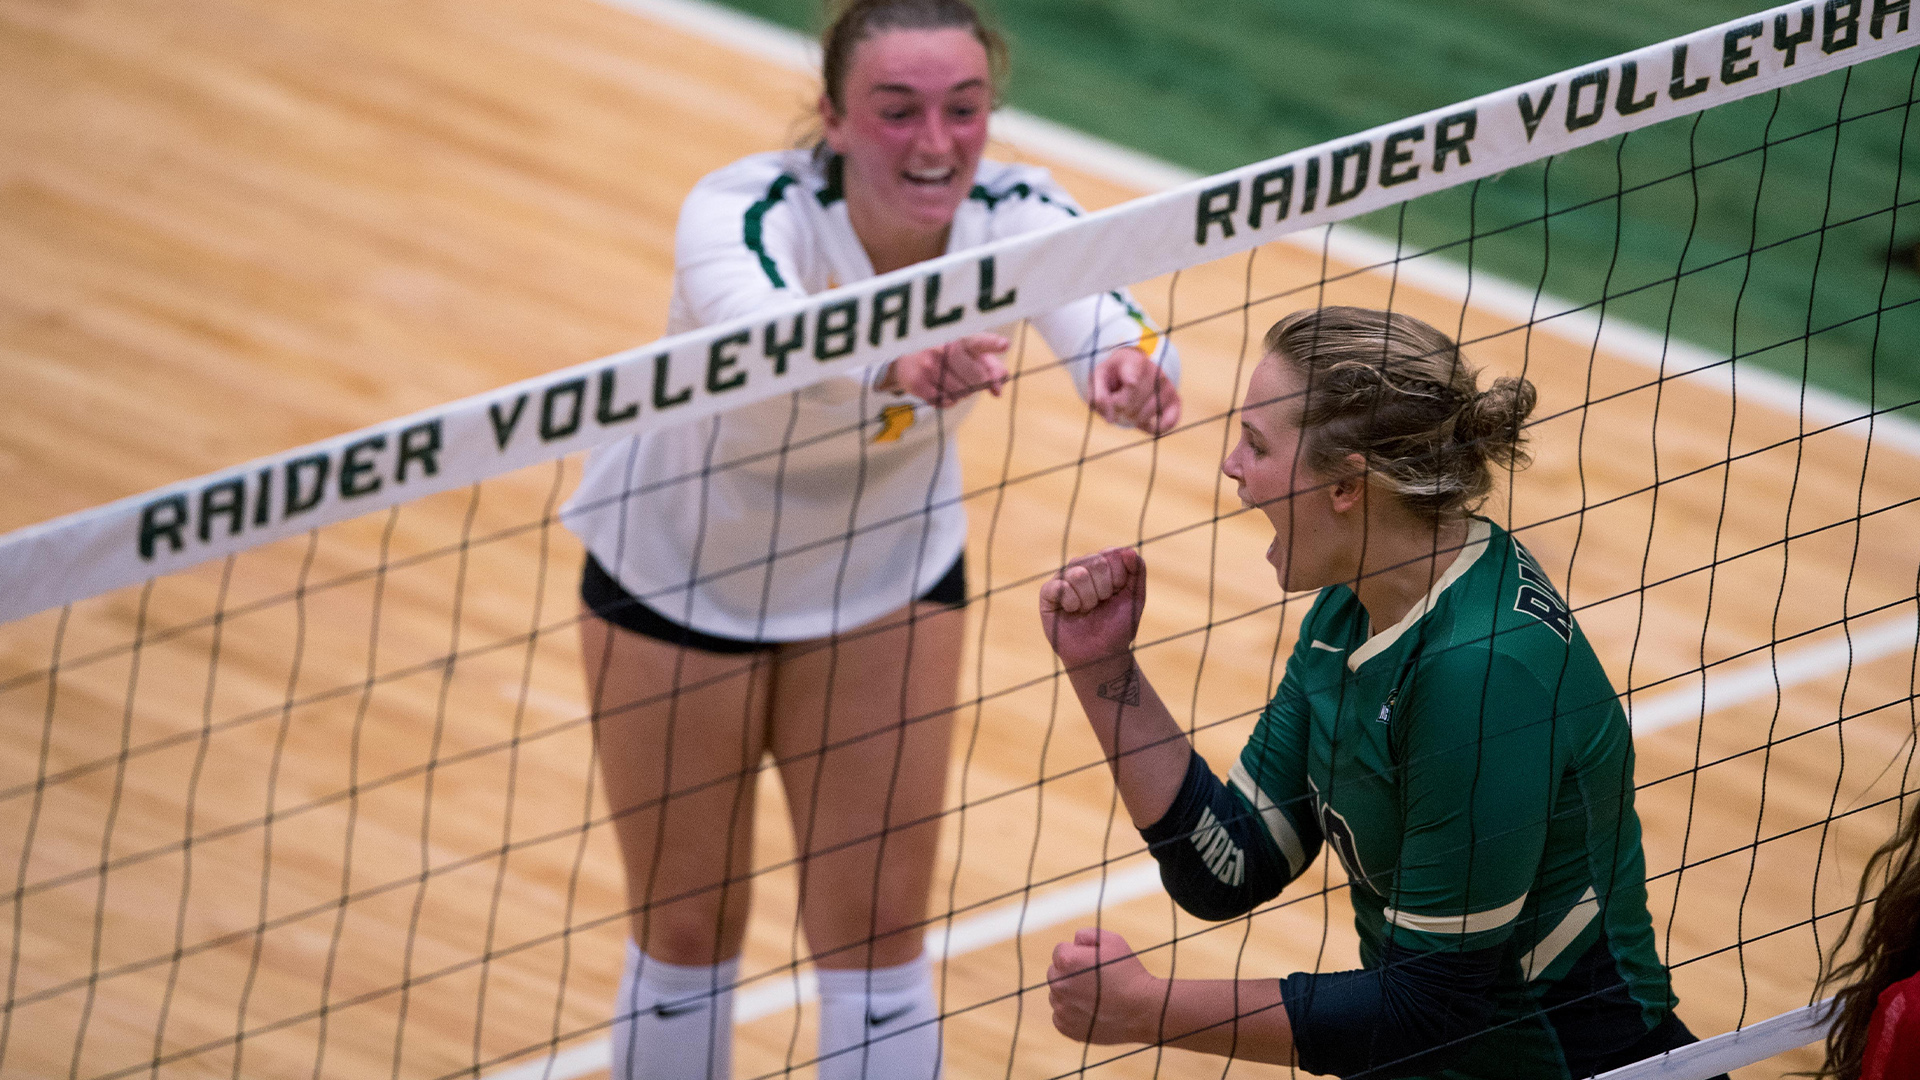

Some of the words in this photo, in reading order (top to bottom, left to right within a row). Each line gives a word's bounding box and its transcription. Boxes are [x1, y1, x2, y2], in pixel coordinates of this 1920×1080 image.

[1195, 108, 1478, 246] RAIDER
[137, 417, 443, 561] RAIDER
[487, 255, 1017, 451] VOLLEYBALL
